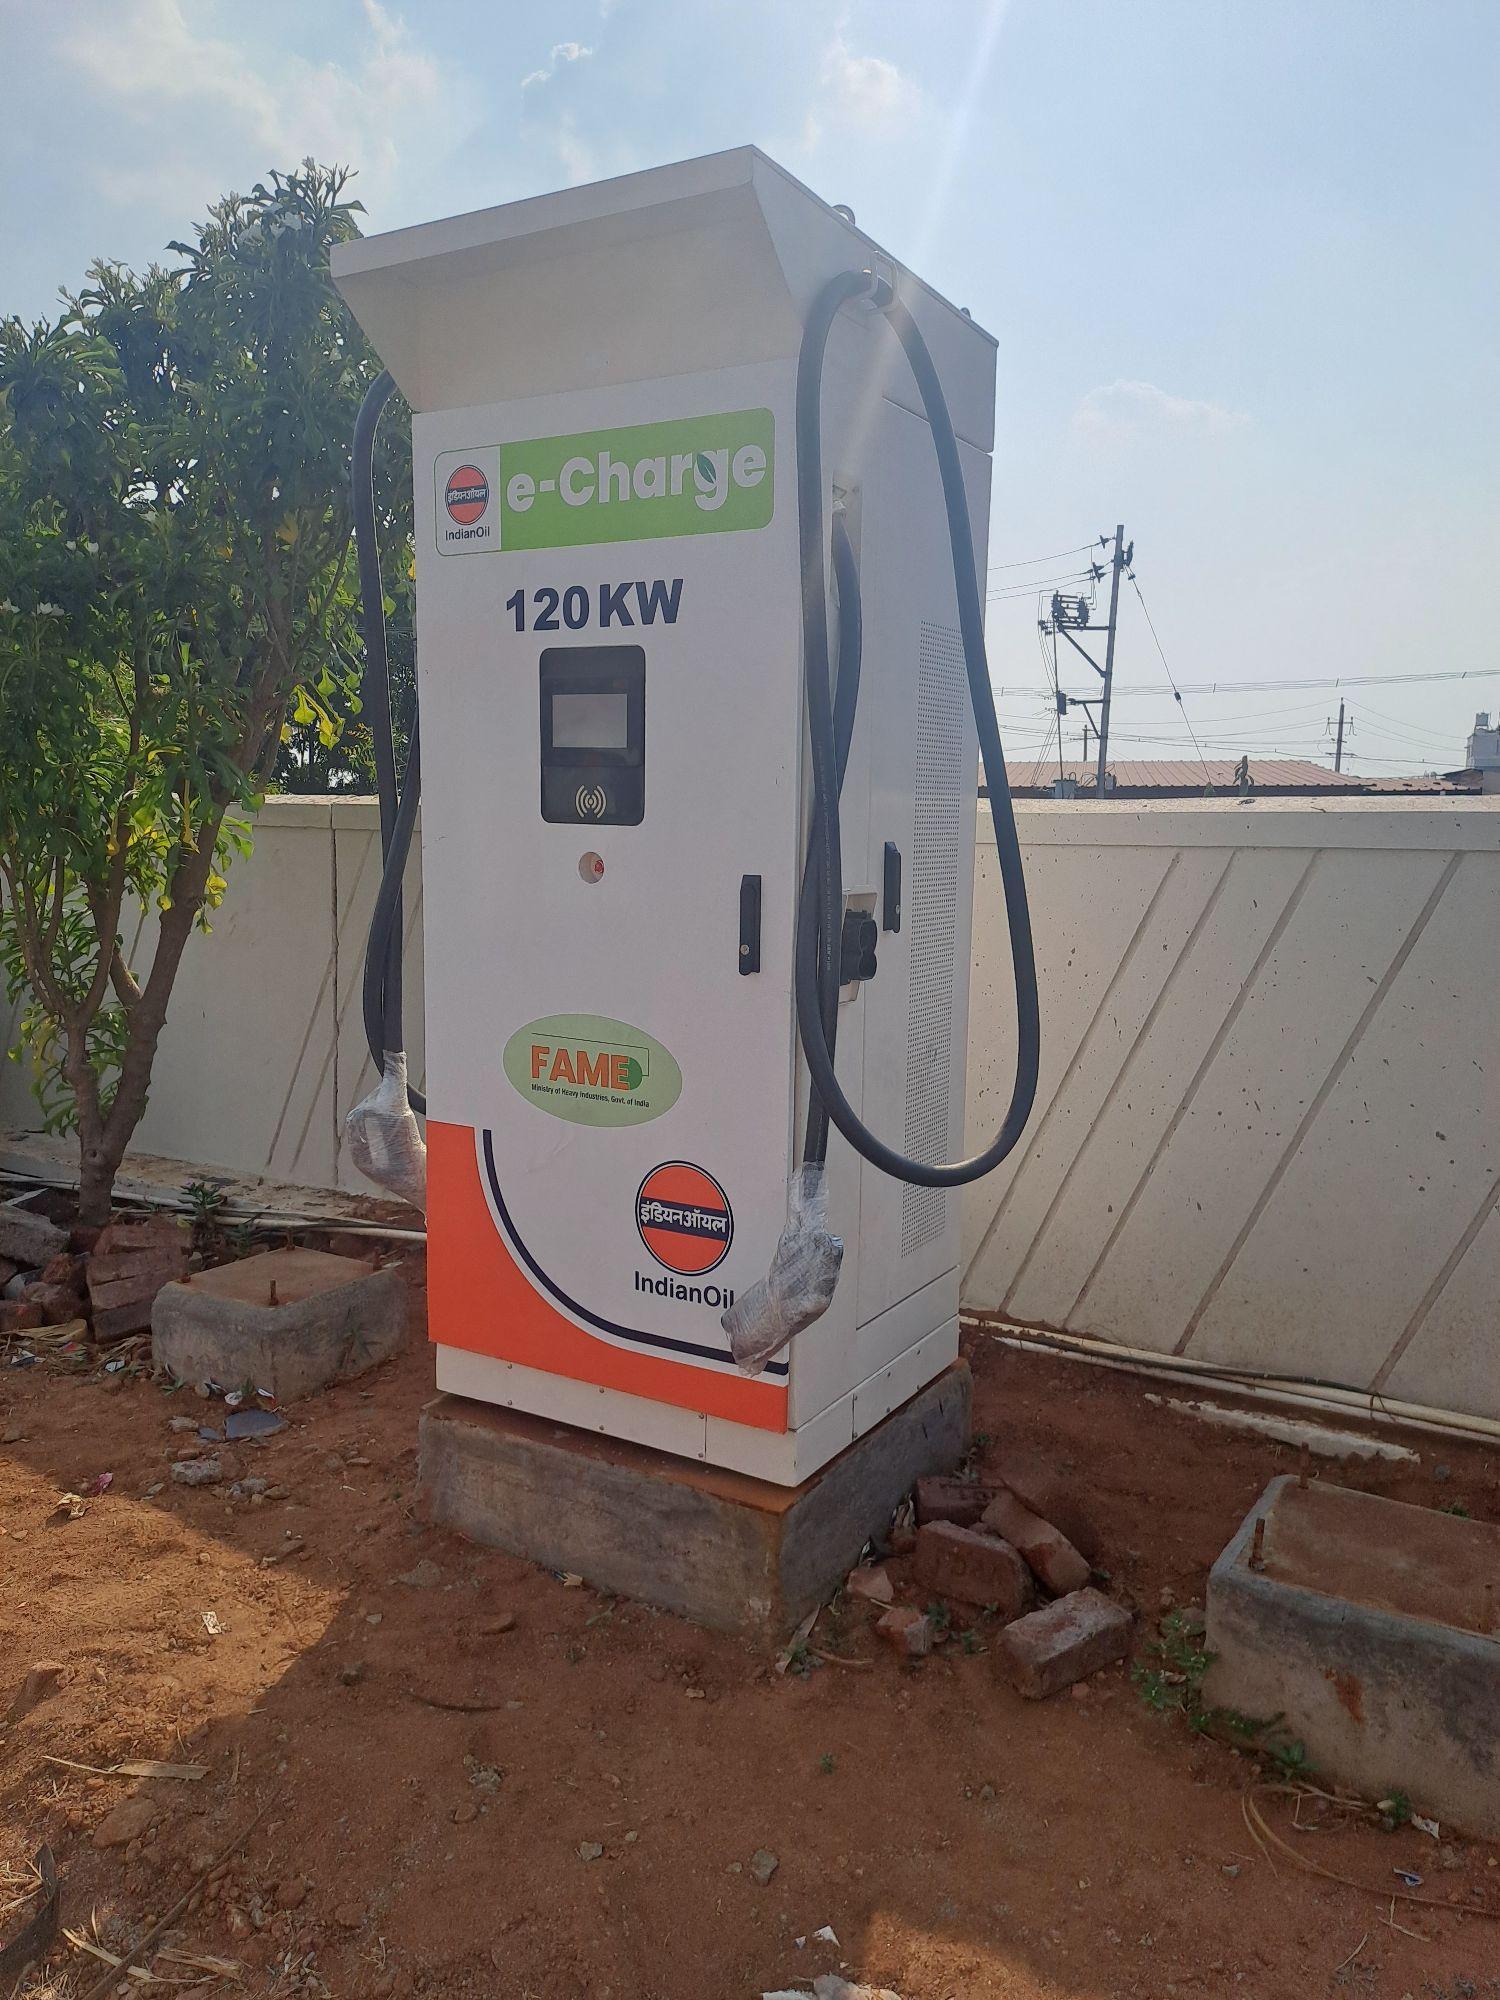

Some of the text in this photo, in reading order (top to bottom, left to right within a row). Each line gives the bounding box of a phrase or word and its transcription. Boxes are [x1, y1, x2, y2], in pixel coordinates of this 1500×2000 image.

[506, 444, 767, 512] e-Charge
[445, 526, 490, 540] IndianOil
[506, 578, 684, 632] 120 KW
[531, 1045, 631, 1091] FAME
[531, 1083, 553, 1094] Ministry
[561, 1088, 578, 1098] Heavy
[579, 1091, 610, 1103] Industries,
[610, 1095, 625, 1105] Govt.
[634, 1099, 650, 1108] India
[640, 1200, 728, 1233] इंडियनऑयल
[634, 1270, 735, 1309] IndianOil
